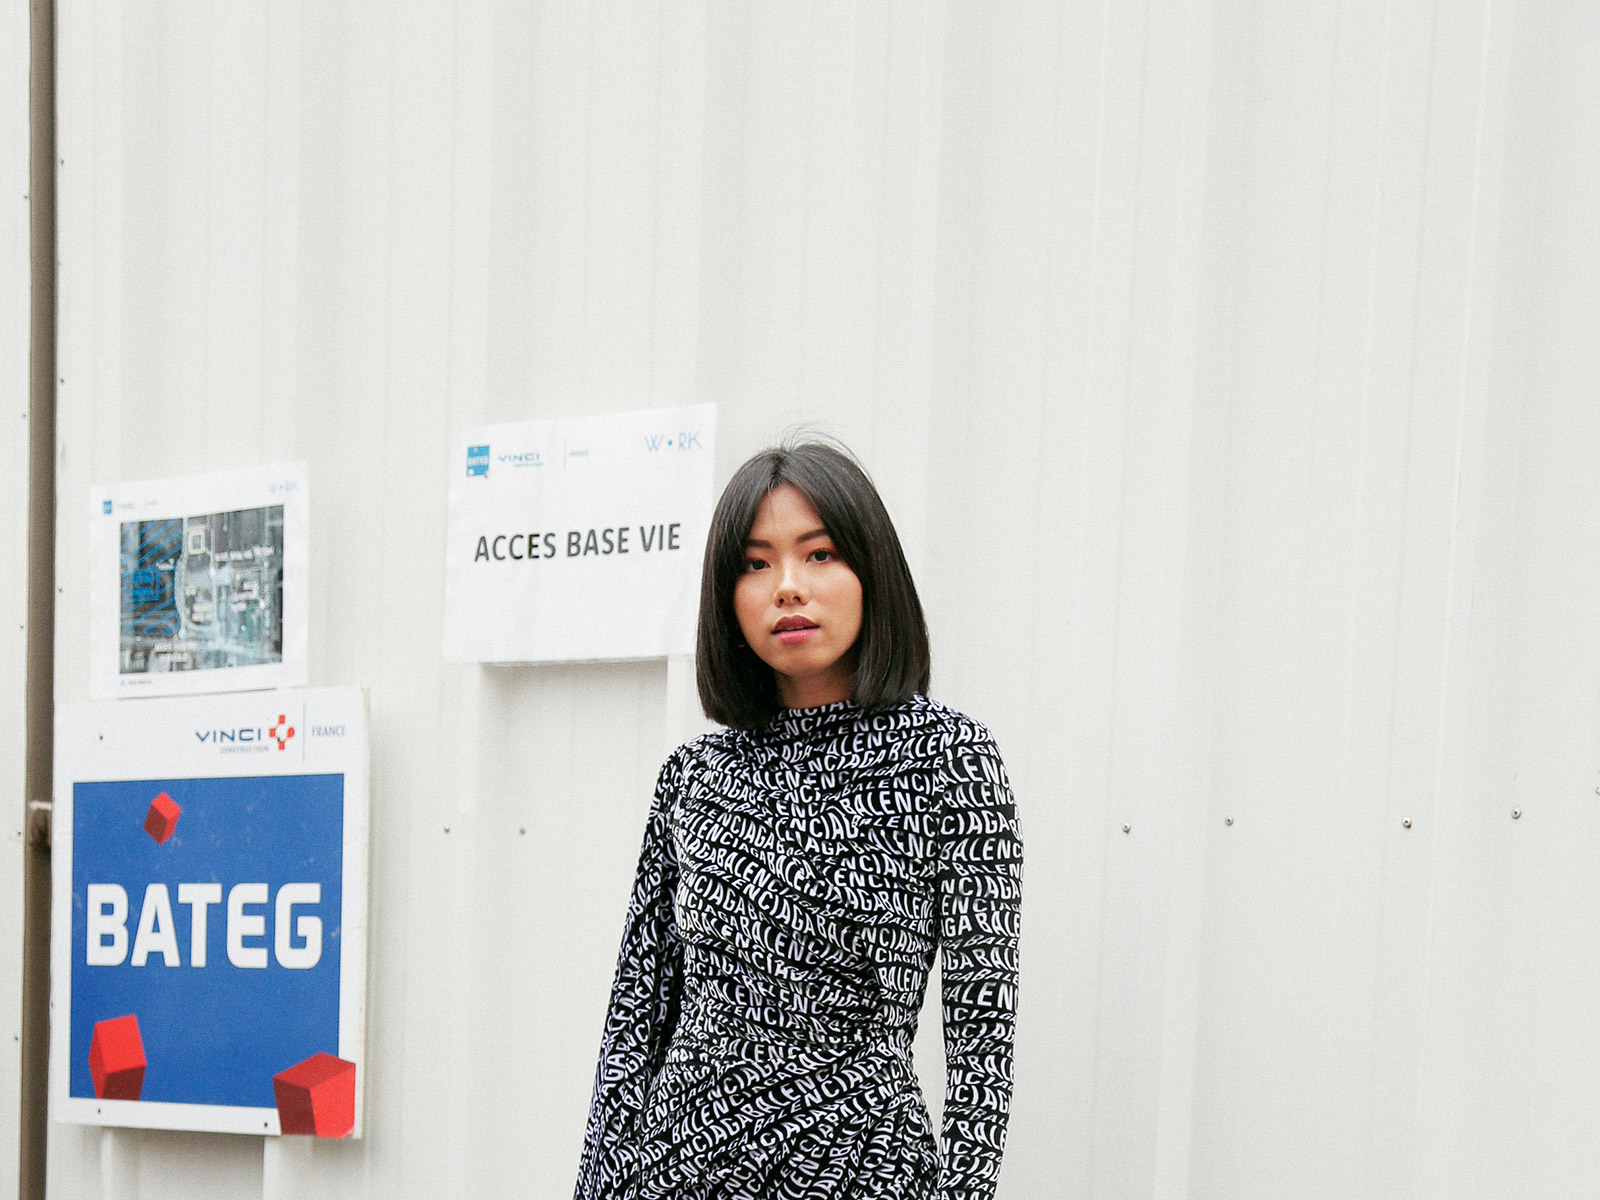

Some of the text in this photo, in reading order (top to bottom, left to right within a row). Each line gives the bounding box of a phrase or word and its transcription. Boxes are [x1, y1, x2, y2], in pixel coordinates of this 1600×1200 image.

[498, 452, 541, 464] VINCI
[474, 523, 681, 562] ACCES BASE VIE
[195, 725, 346, 743] VINCI FRANCE
[86, 882, 323, 970] BATEG
